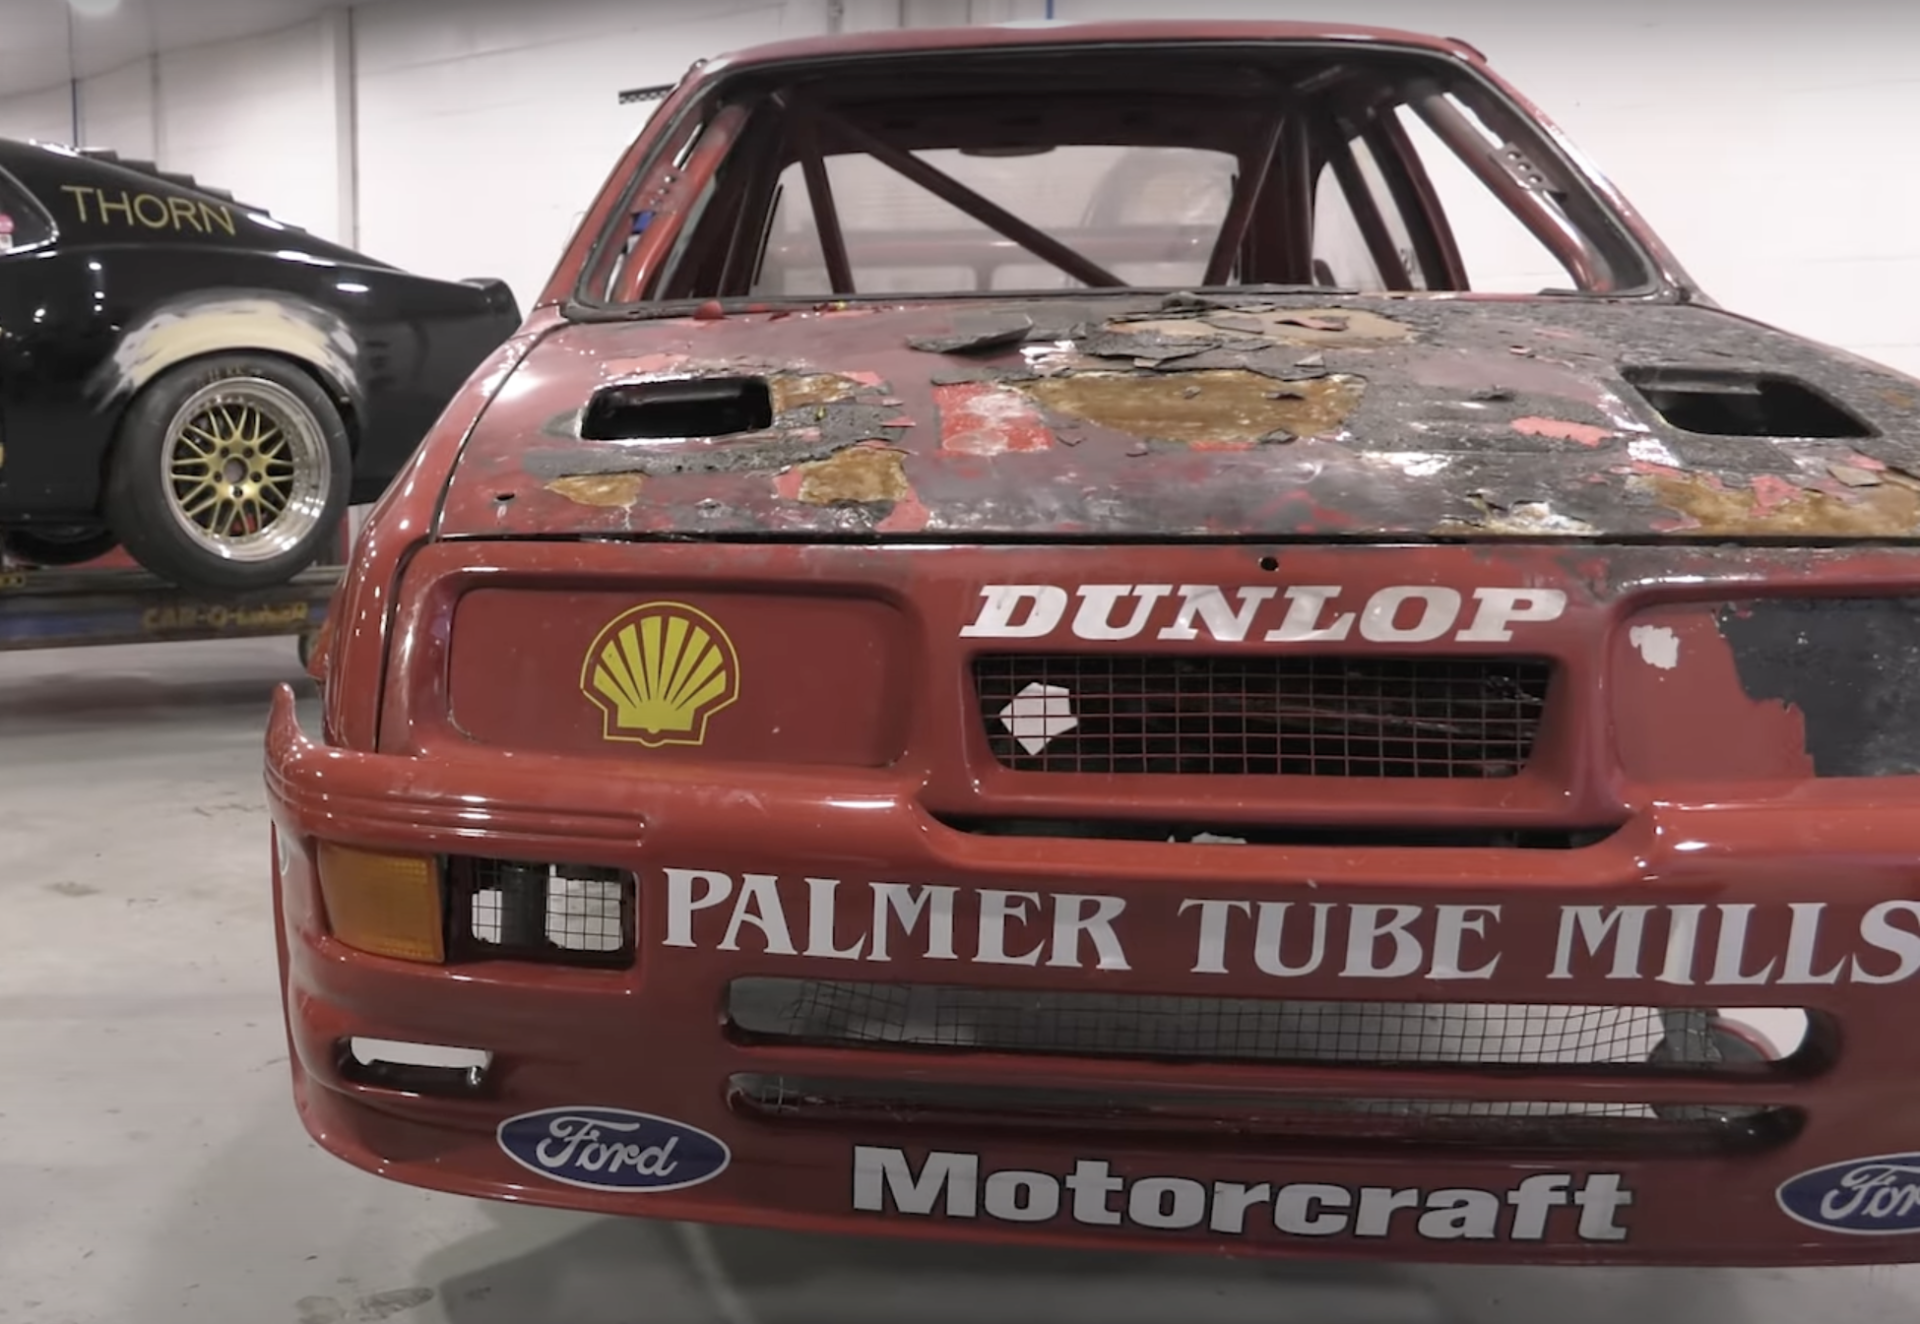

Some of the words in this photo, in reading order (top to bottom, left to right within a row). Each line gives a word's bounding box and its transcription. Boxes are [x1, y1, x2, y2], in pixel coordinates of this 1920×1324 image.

[60, 184, 236, 236] THORN
[958, 583, 1568, 643] DUNLOP
[661, 866, 1132, 970] PALMER
[1177, 898, 1504, 980] TUBE
[1545, 899, 1920, 986] MILLS
[535, 1115, 680, 1178] Ford
[851, 1144, 1634, 1243] Motorcraft
[1820, 1163, 1920, 1221] For
